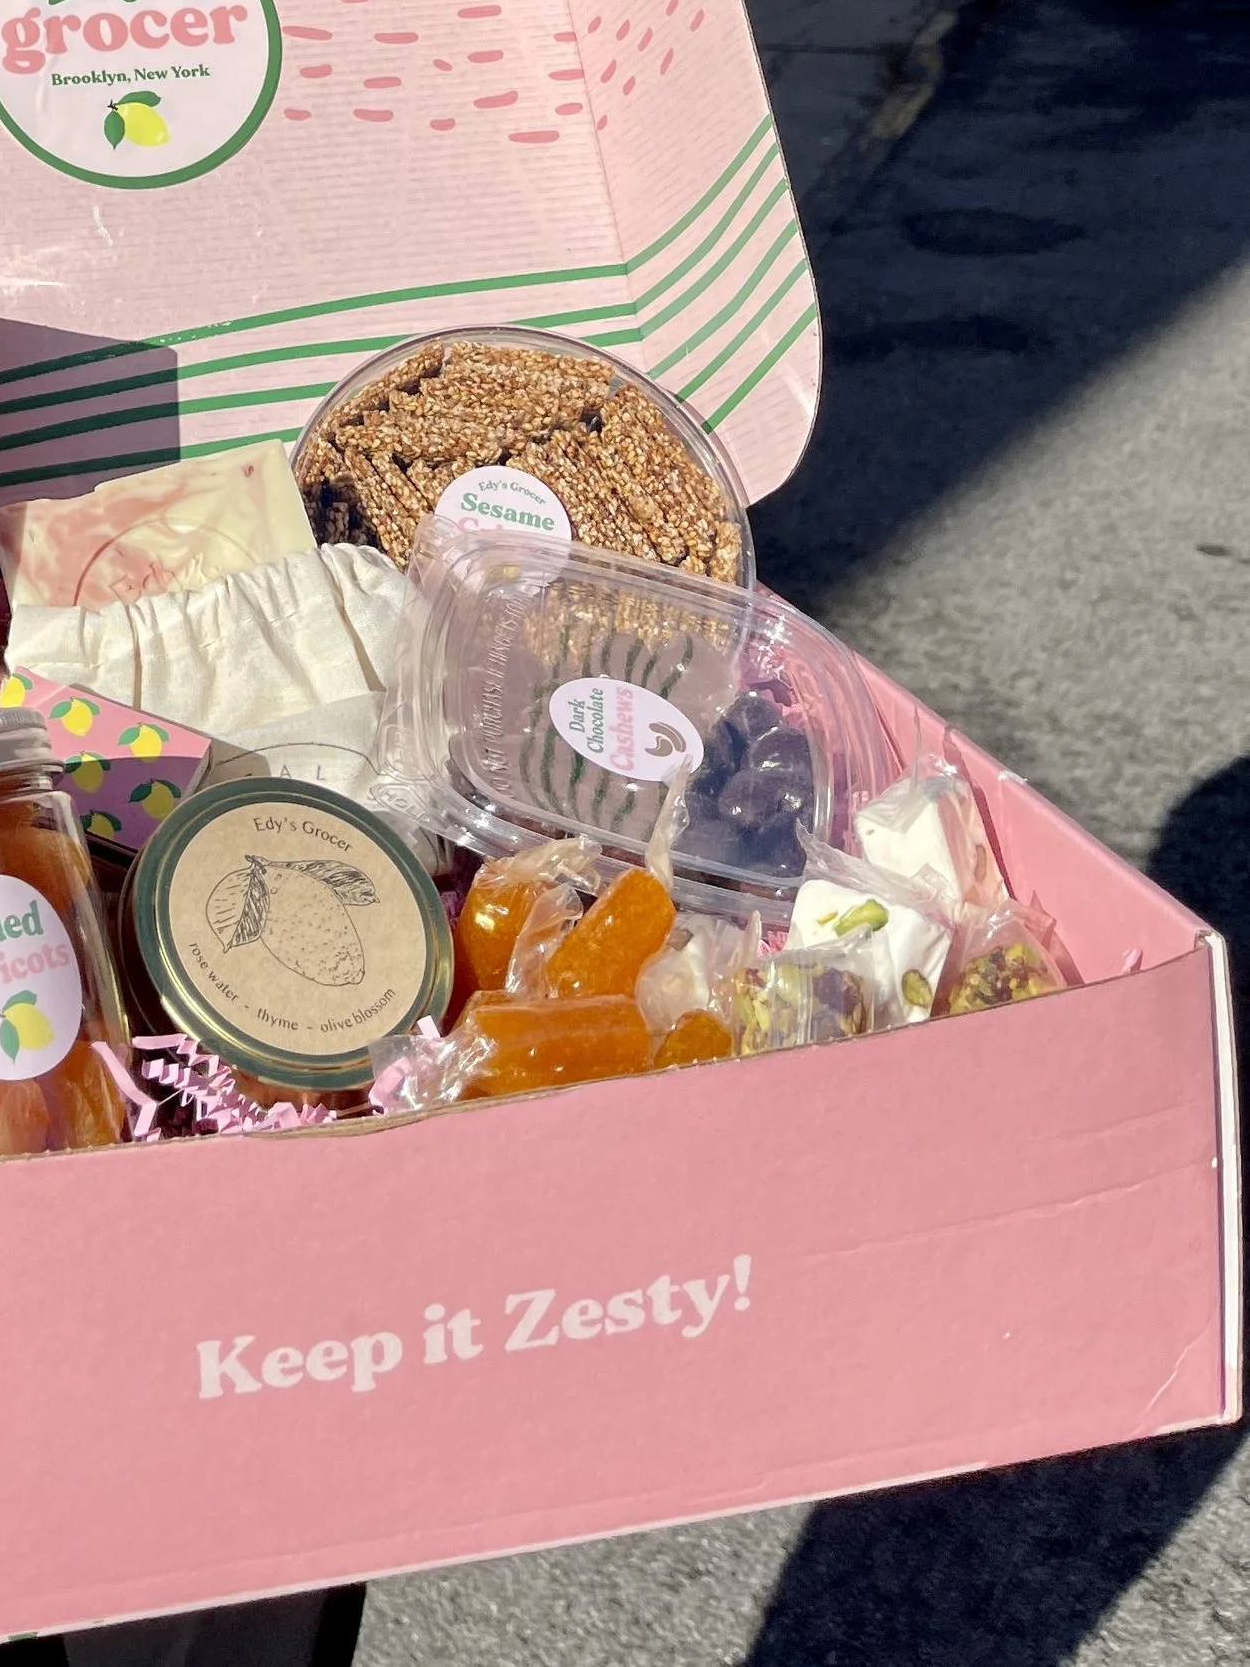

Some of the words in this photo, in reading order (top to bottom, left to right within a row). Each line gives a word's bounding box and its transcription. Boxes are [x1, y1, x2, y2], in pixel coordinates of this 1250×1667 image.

[1, 5, 248, 75] grocer
[52, 70, 131, 86] Brooklyn,
[134, 66, 168, 81] New
[171, 64, 210, 79] York
[461, 492, 555, 531] Sesame
[478, 480, 508, 492] Edy's
[510, 482, 546, 505] Grocer
[568, 699, 585, 733] Dark
[586, 688, 604, 753] Chocolate
[609, 687, 634, 771] Cashews
[254, 817, 297, 834] Edy's
[303, 820, 353, 852] Grocer
[188, 942, 209, 969] rose
[208, 970, 240, 1002] water
[257, 1007, 298, 1031] thyme
[320, 1016, 352, 1032] olive
[352, 987, 396, 1024] blossom
[196, 1331, 402, 1399] Keep
[423, 1303, 484, 1365] it
[504, 1253, 752, 1352] Zesty!
